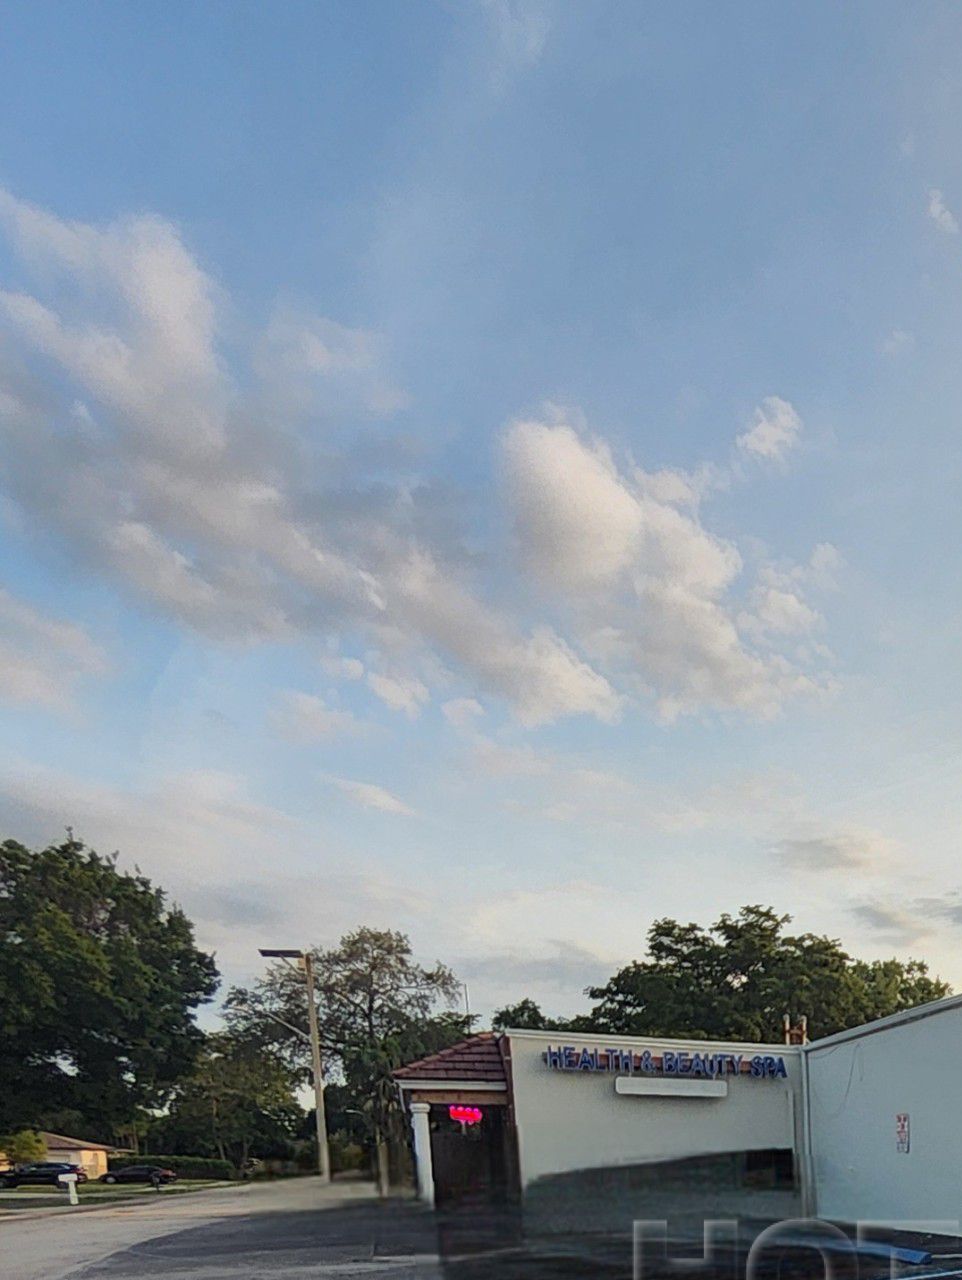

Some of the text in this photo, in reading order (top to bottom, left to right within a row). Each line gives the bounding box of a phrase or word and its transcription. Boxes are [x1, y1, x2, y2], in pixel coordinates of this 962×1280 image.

[547, 1045, 788, 1078] HEALTH & BEAUTY SPA
